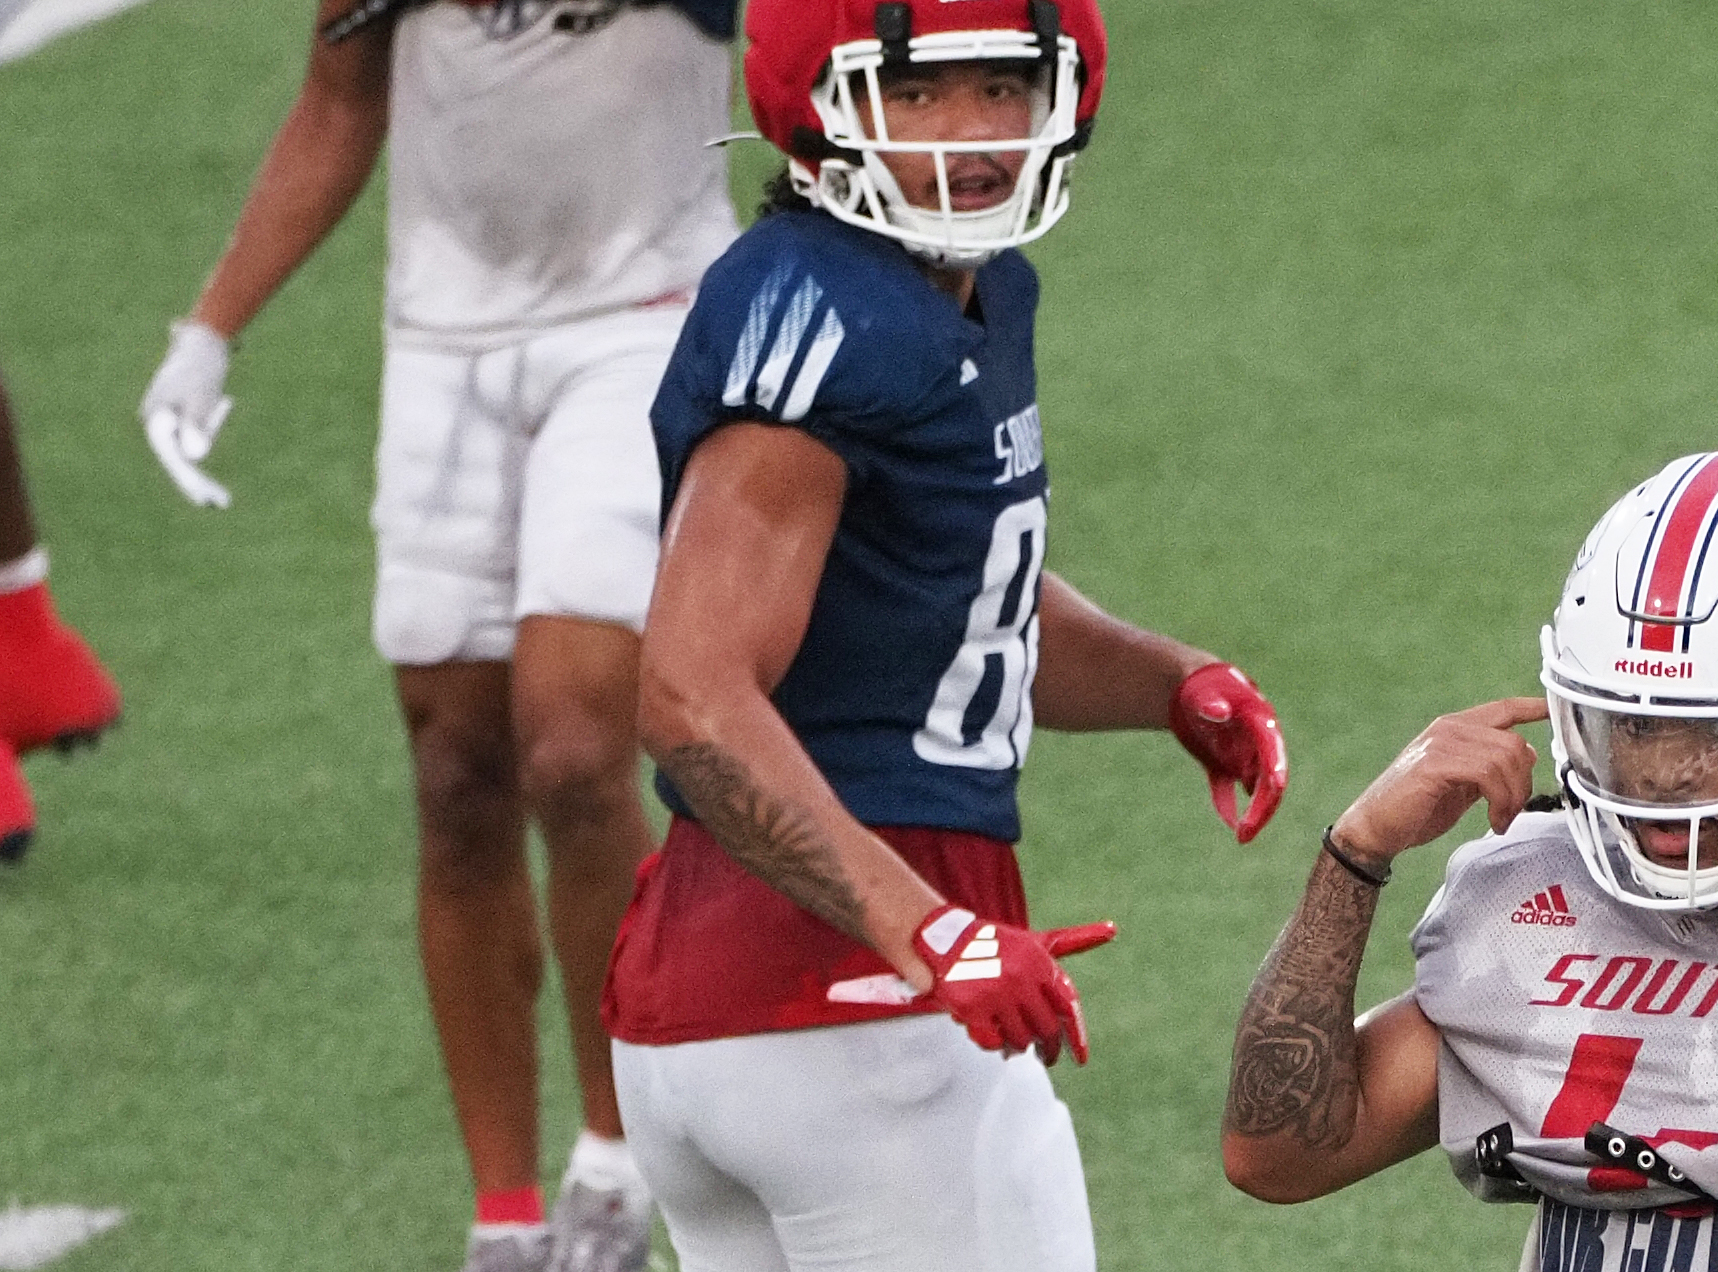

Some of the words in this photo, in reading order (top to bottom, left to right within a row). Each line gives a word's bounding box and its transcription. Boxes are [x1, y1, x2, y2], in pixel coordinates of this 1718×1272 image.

[911, 486, 1050, 771] 8
[1614, 658, 1693, 679] Riddell
[1511, 909, 1577, 927] adidas
